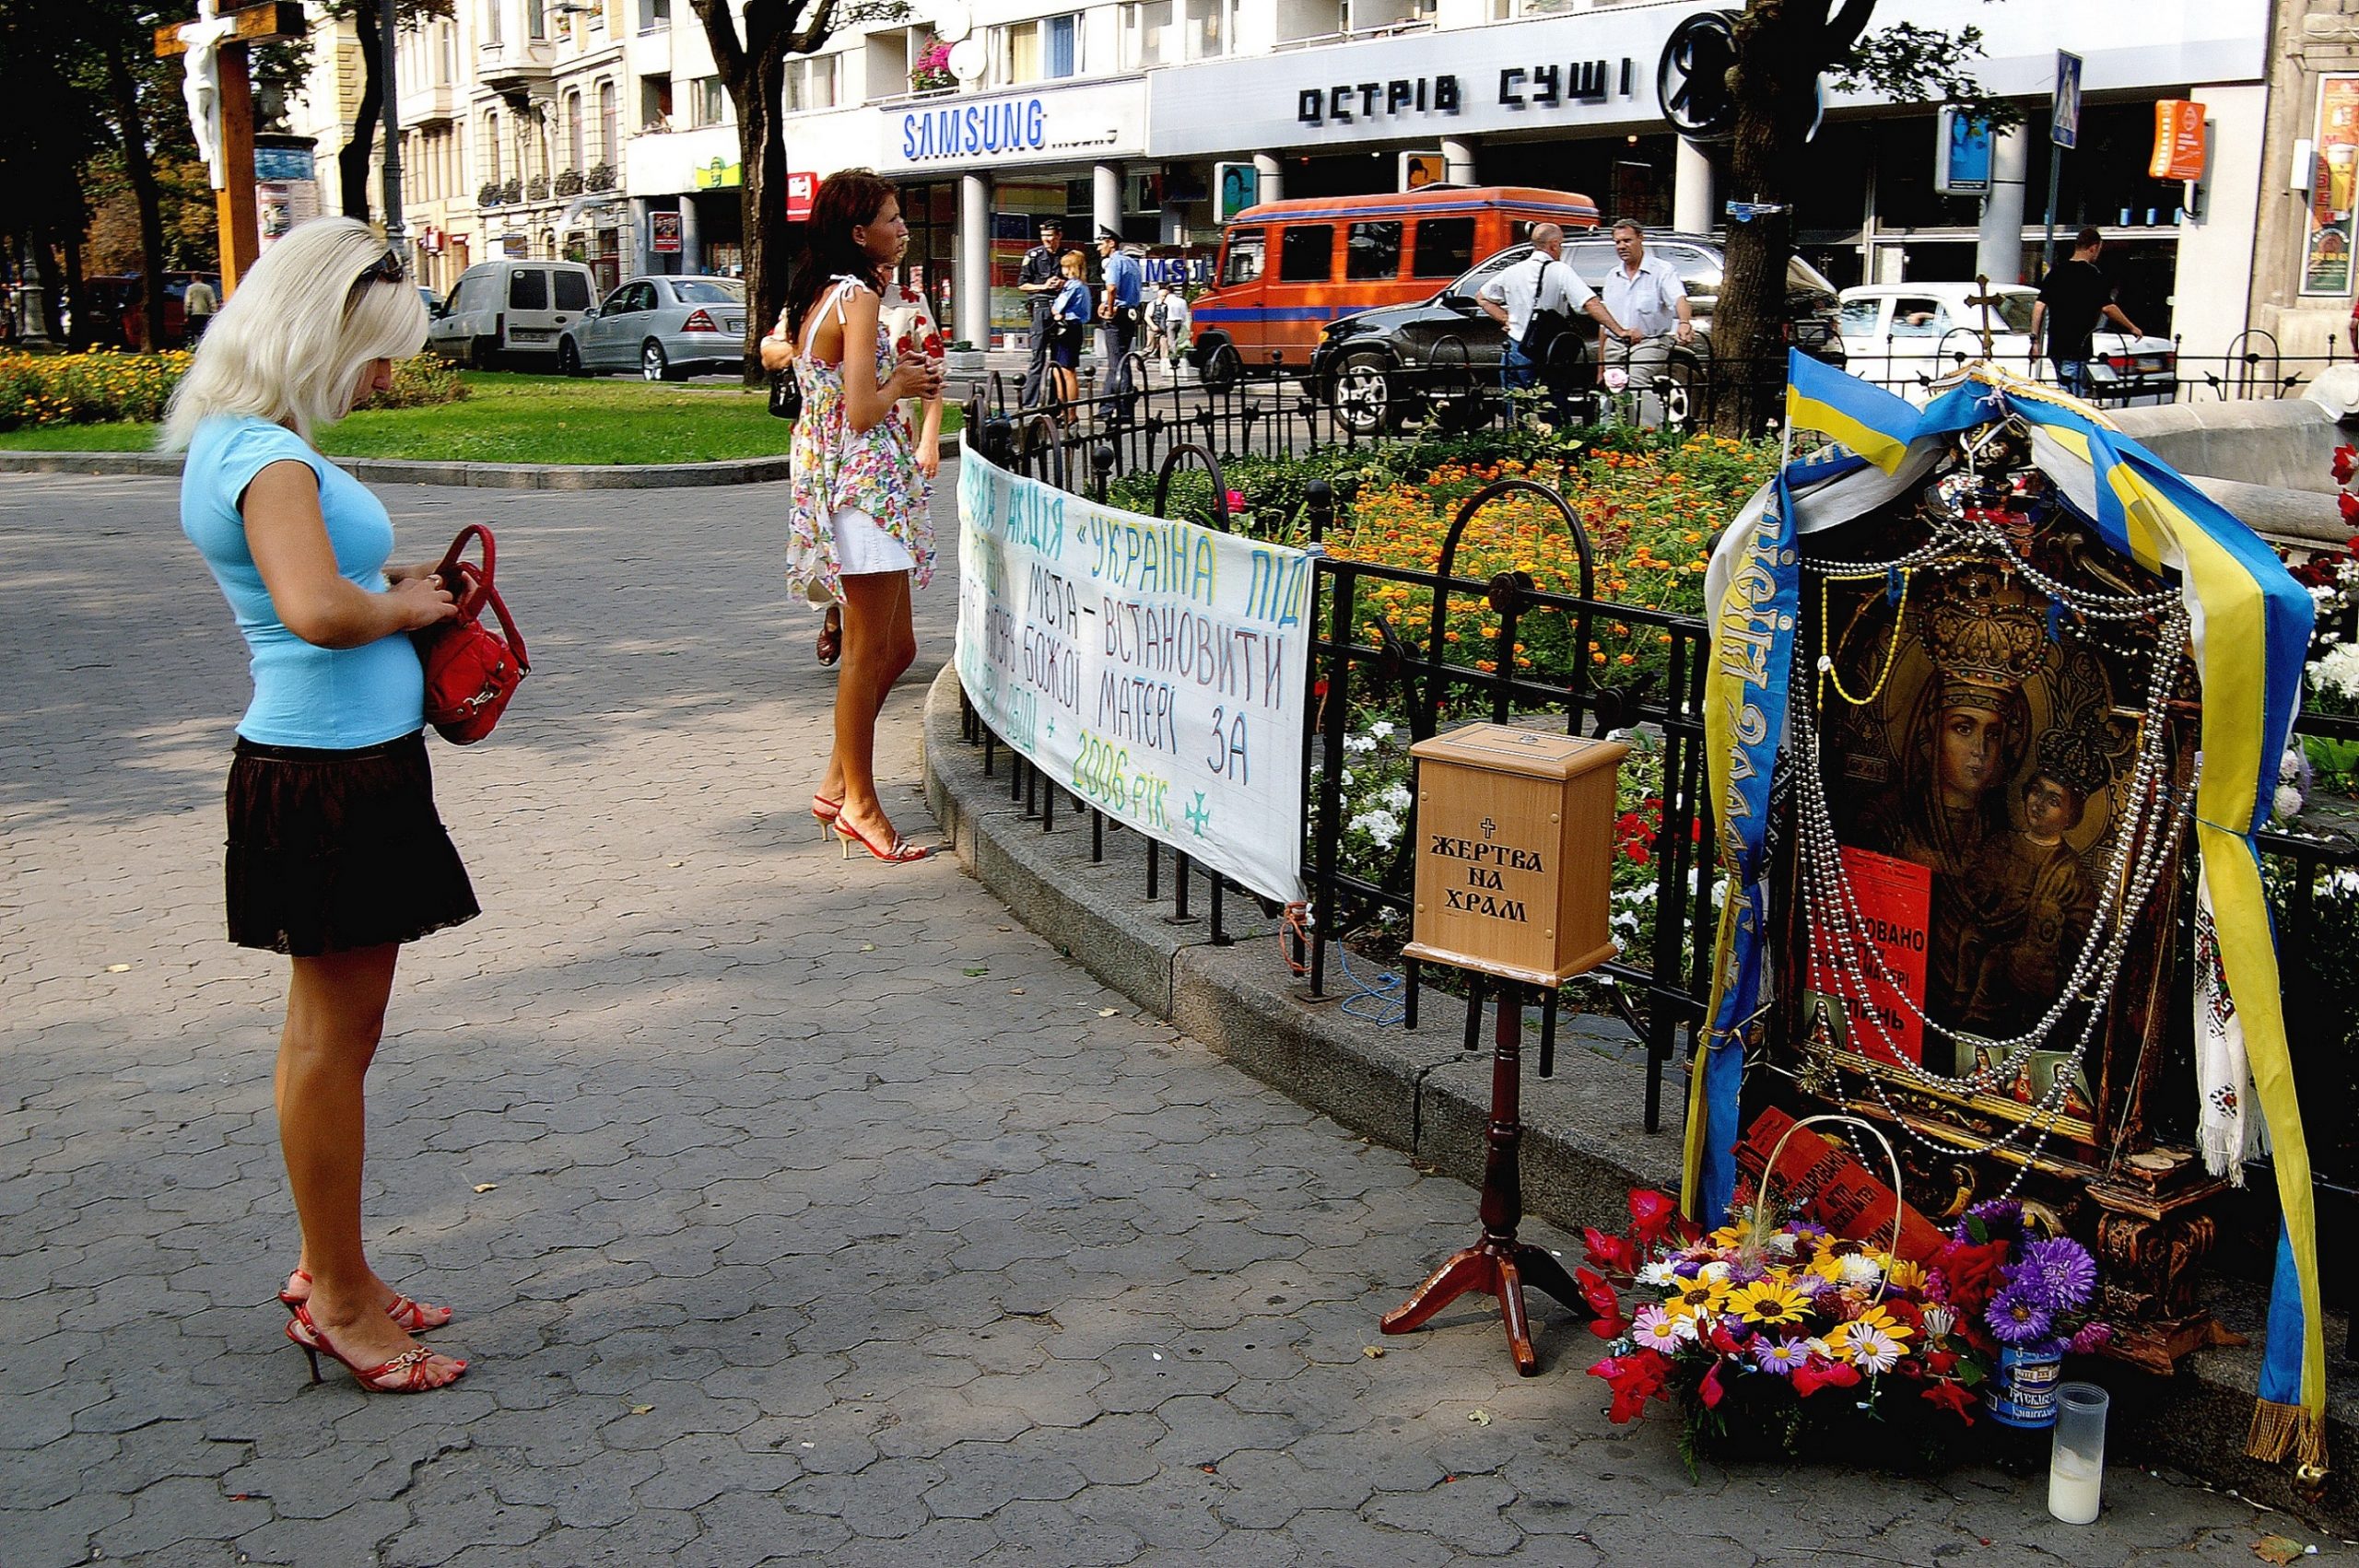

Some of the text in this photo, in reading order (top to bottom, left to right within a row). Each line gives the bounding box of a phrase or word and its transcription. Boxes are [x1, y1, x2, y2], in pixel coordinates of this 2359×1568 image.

[1297, 57, 1632, 123] ОСТРІВ СУШІ
[903, 99, 1043, 158] SAMSUNG
[1003, 480, 1064, 560] АКЦІЯ
[1246, 546, 1307, 629] ПІД
[1103, 594, 1284, 710] ВСТАНОВИТИ
[1024, 624, 1082, 716] БОЖОЇ
[1207, 705, 1250, 786] ЗА
[1072, 729, 1129, 812] 2006
[1430, 835, 1544, 873] ЖЕРТВА
[1467, 867, 1505, 892] НА
[1445, 888, 1529, 923] ХРАМ
